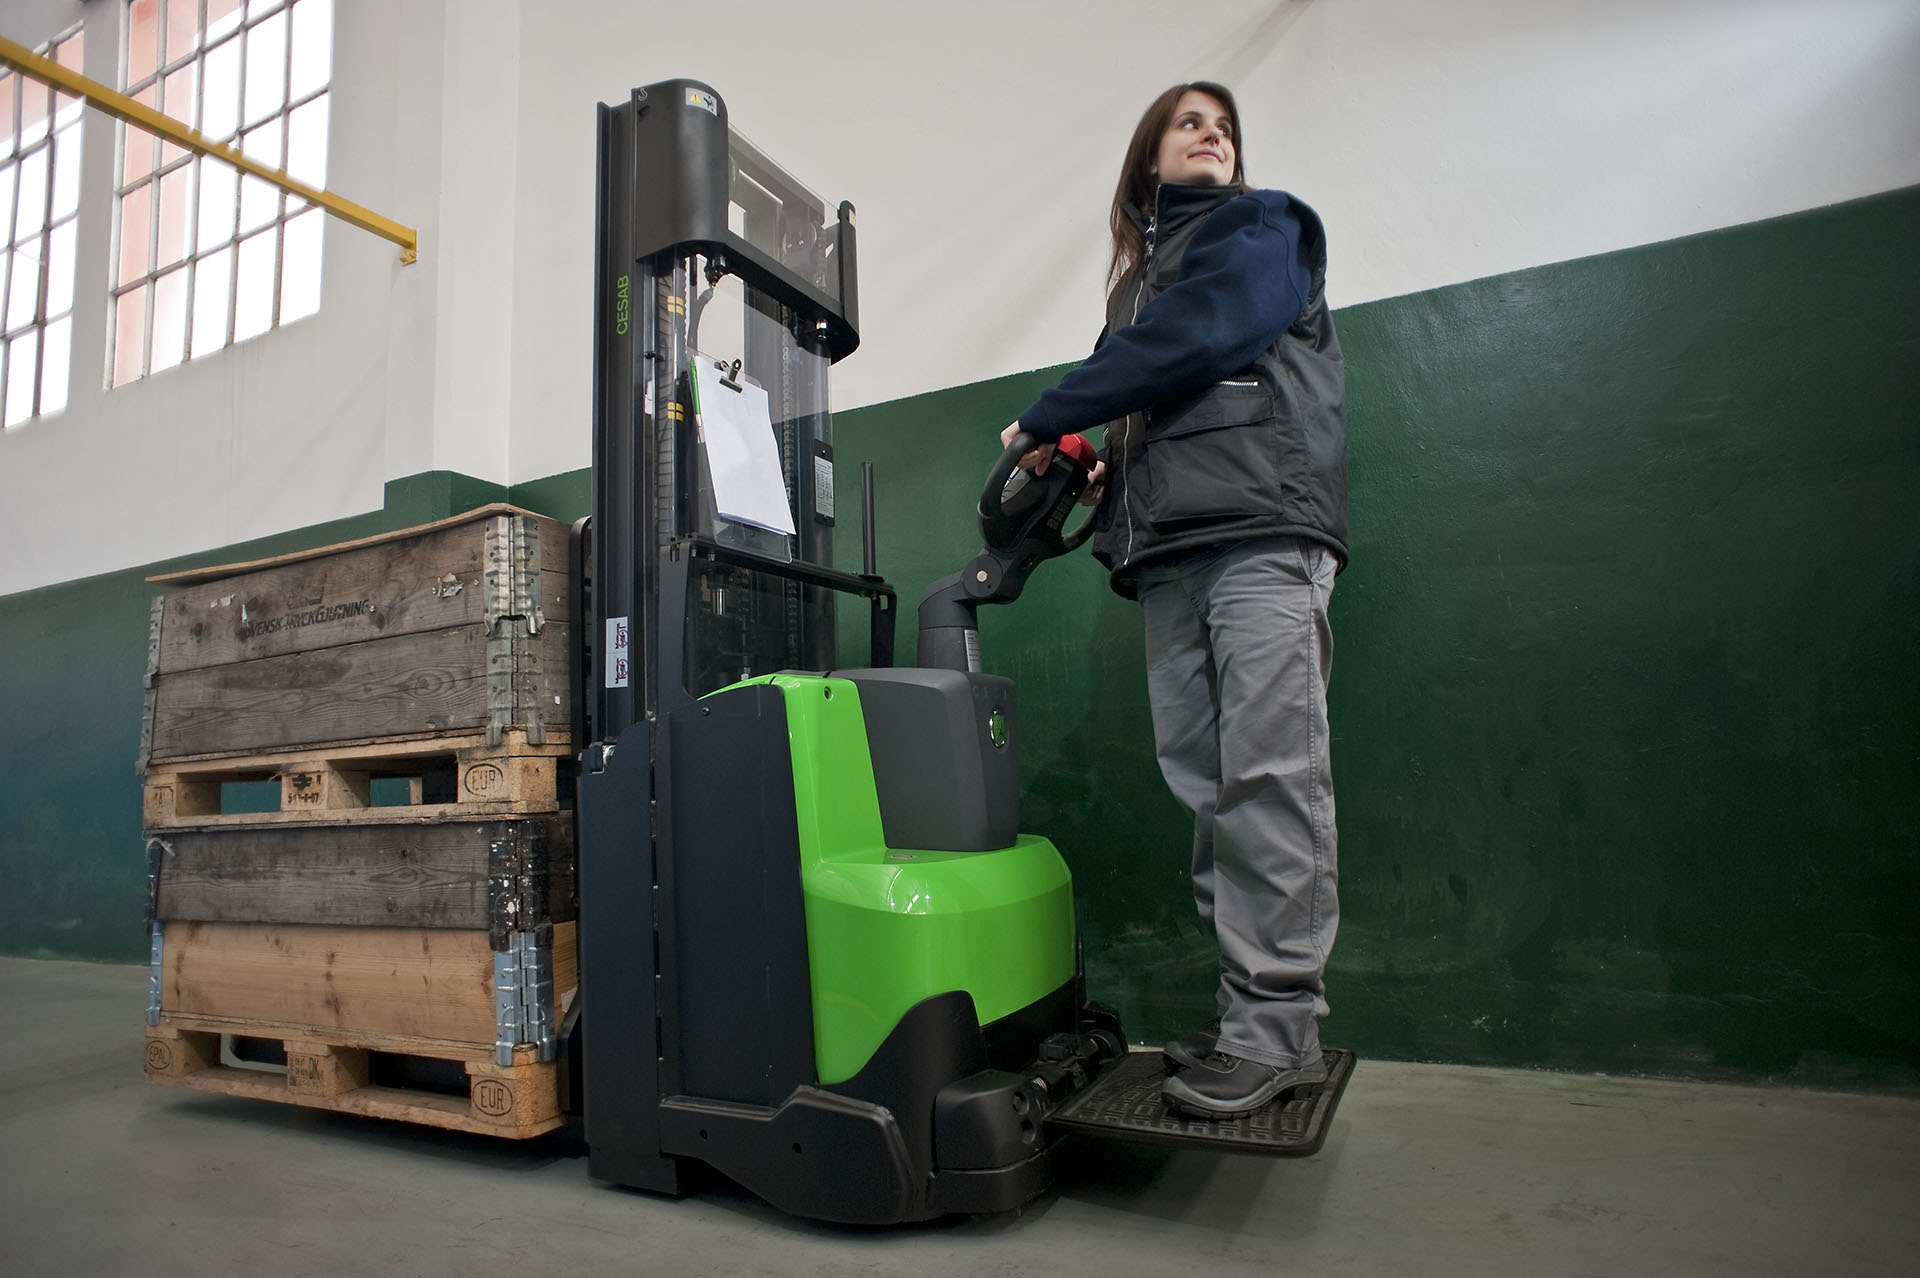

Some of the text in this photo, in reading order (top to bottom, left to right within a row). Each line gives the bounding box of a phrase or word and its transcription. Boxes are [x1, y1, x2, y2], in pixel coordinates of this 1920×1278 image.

[616, 274, 629, 335] CESAB
[472, 769, 497, 790] EUR
[480, 1085, 504, 1111] EUR
